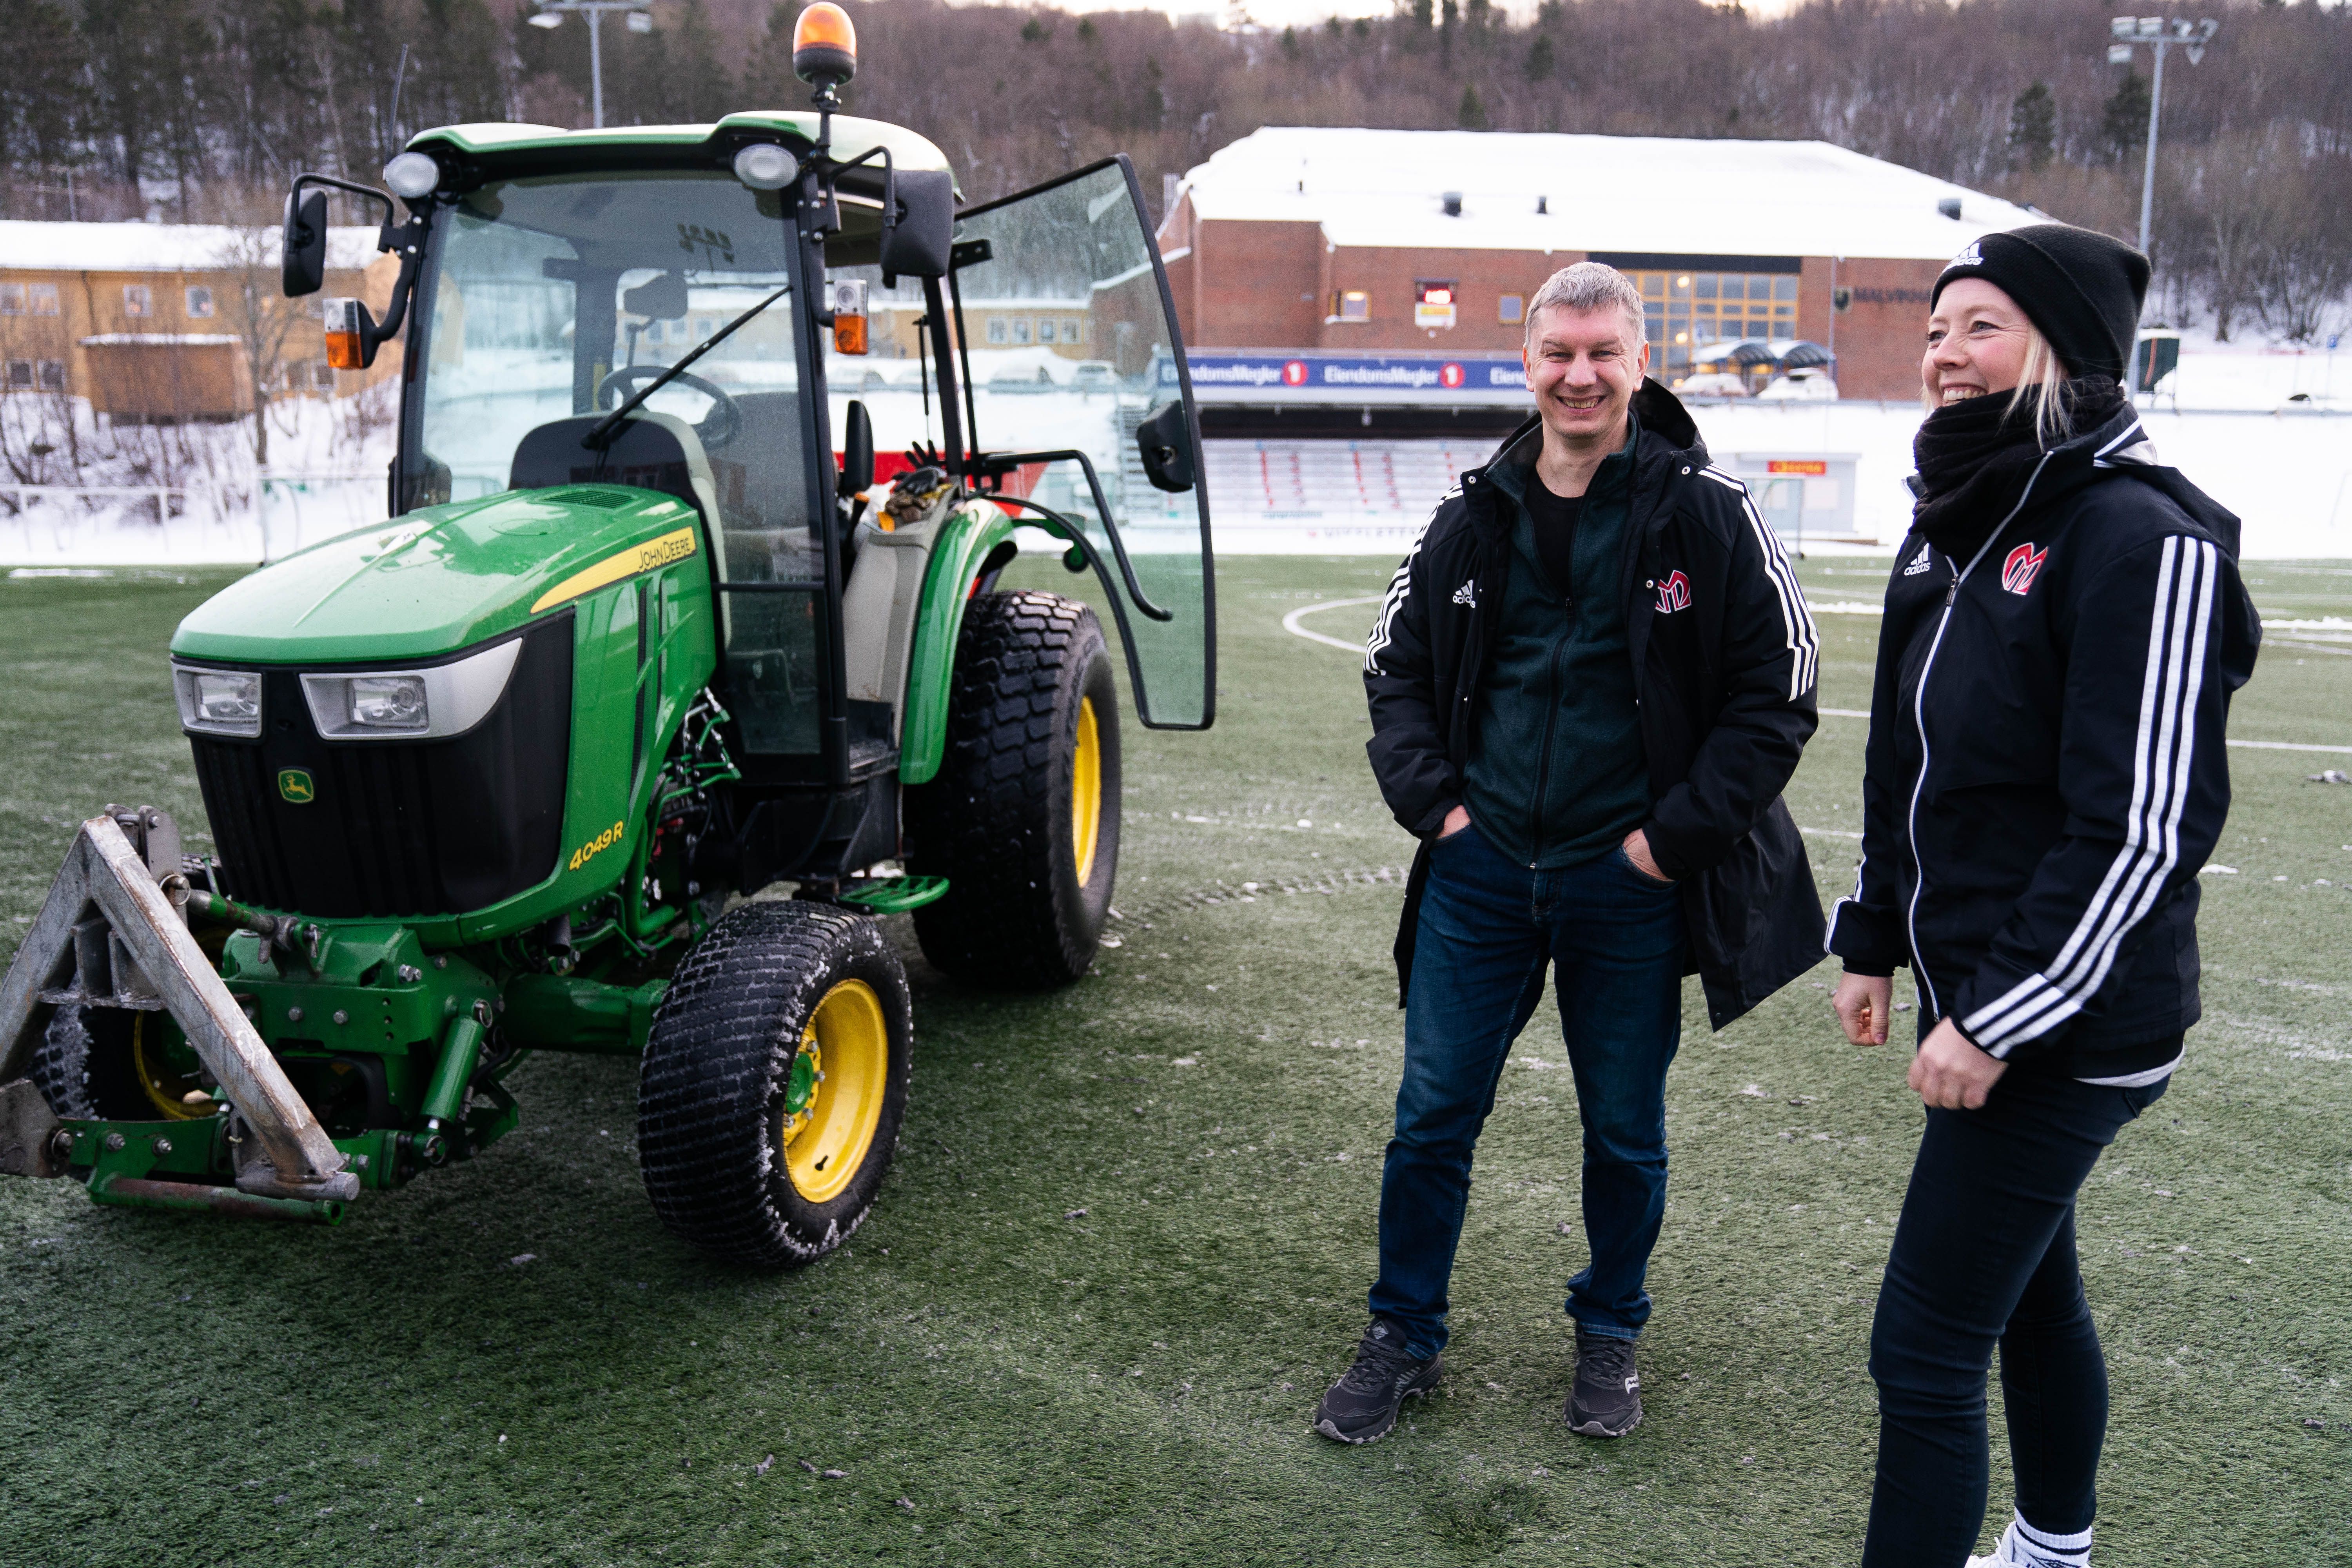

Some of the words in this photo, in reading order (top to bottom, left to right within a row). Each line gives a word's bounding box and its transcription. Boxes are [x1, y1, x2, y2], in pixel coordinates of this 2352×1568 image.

[1288, 363, 1301, 383] 1
[1445, 365, 1458, 385] 1
[639, 546, 663, 568] JOHN
[663, 536, 690, 559] DEERE
[1904, 562, 1931, 576] adidas
[1453, 595, 1475, 608] adidas
